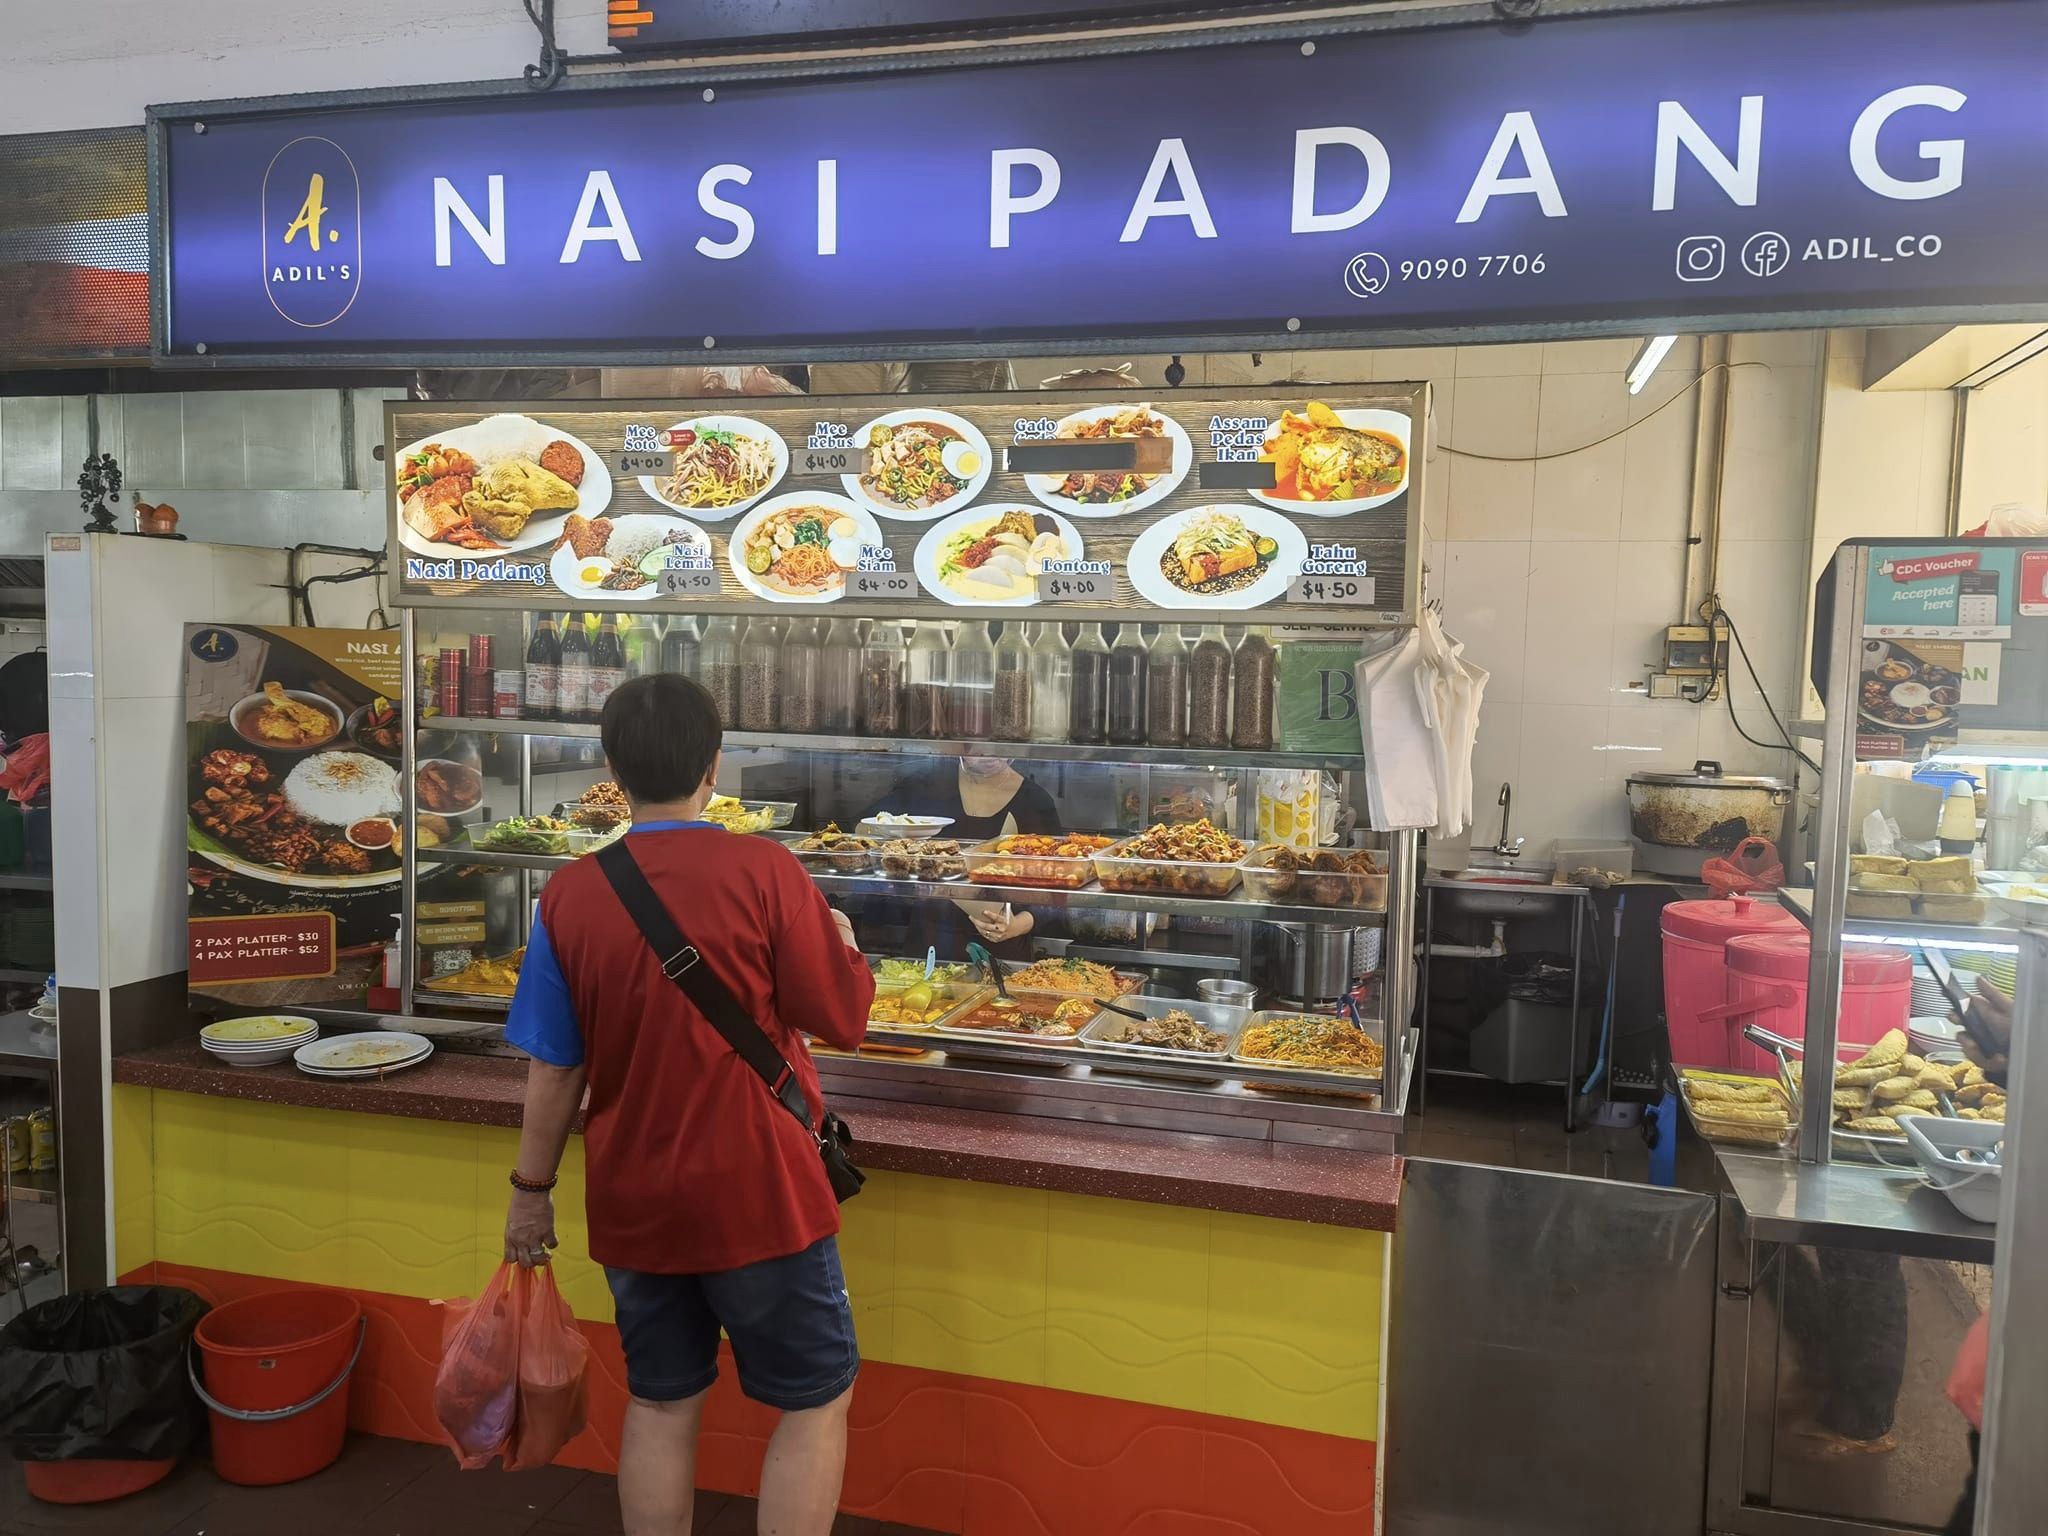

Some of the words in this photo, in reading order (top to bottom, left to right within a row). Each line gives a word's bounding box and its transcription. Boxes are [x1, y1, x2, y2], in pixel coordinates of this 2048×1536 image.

[433, 159, 837, 267] NASI
[989, 84, 1968, 248] PADANG
[1802, 235, 1942, 262] ADIL_CO
[272, 264, 350, 282] ADIL'S
[1400, 258, 1467, 282] 9090
[1477, 253, 1547, 277] 7706
[816, 423, 847, 435] Mee
[1015, 418, 1056, 432] Gado
[1210, 416, 1267, 429] Assam
[626, 425, 655, 438] Mee
[1212, 431, 1264, 445] Pedas
[625, 438, 657, 450] Soto
[809, 436, 854, 448] Rebus
[1217, 447, 1257, 461] Ikan
[674, 544, 704, 556] Nasi
[861, 545, 892, 558] Mee
[1312, 545, 1355, 559] Tahu
[666, 557, 713, 569] Lemak
[858, 559, 896, 572] Siam
[1043, 559, 1111, 575] Lontong
[1301, 560, 1366, 576] Goreng
[1896, 563, 1922, 575] CDC
[1925, 559, 1973, 571] Voucher
[407, 559, 455, 579] Nasi
[461, 559, 545, 584] Padang
[1893, 584, 1955, 601] Accepted
[1923, 600, 1954, 611] here
[347, 642, 388, 654] NASI
[1315, 669, 1357, 722] B
[195, 939, 202, 947] 2
[207, 938, 232, 946] PAX
[237, 934, 293, 944] PLATTER-
[298, 932, 319, 941] $30
[195, 952, 203, 960] 4
[208, 951, 233, 959] PAX
[238, 947, 294, 958] PLATTER-
[299, 945, 319, 954] $52
